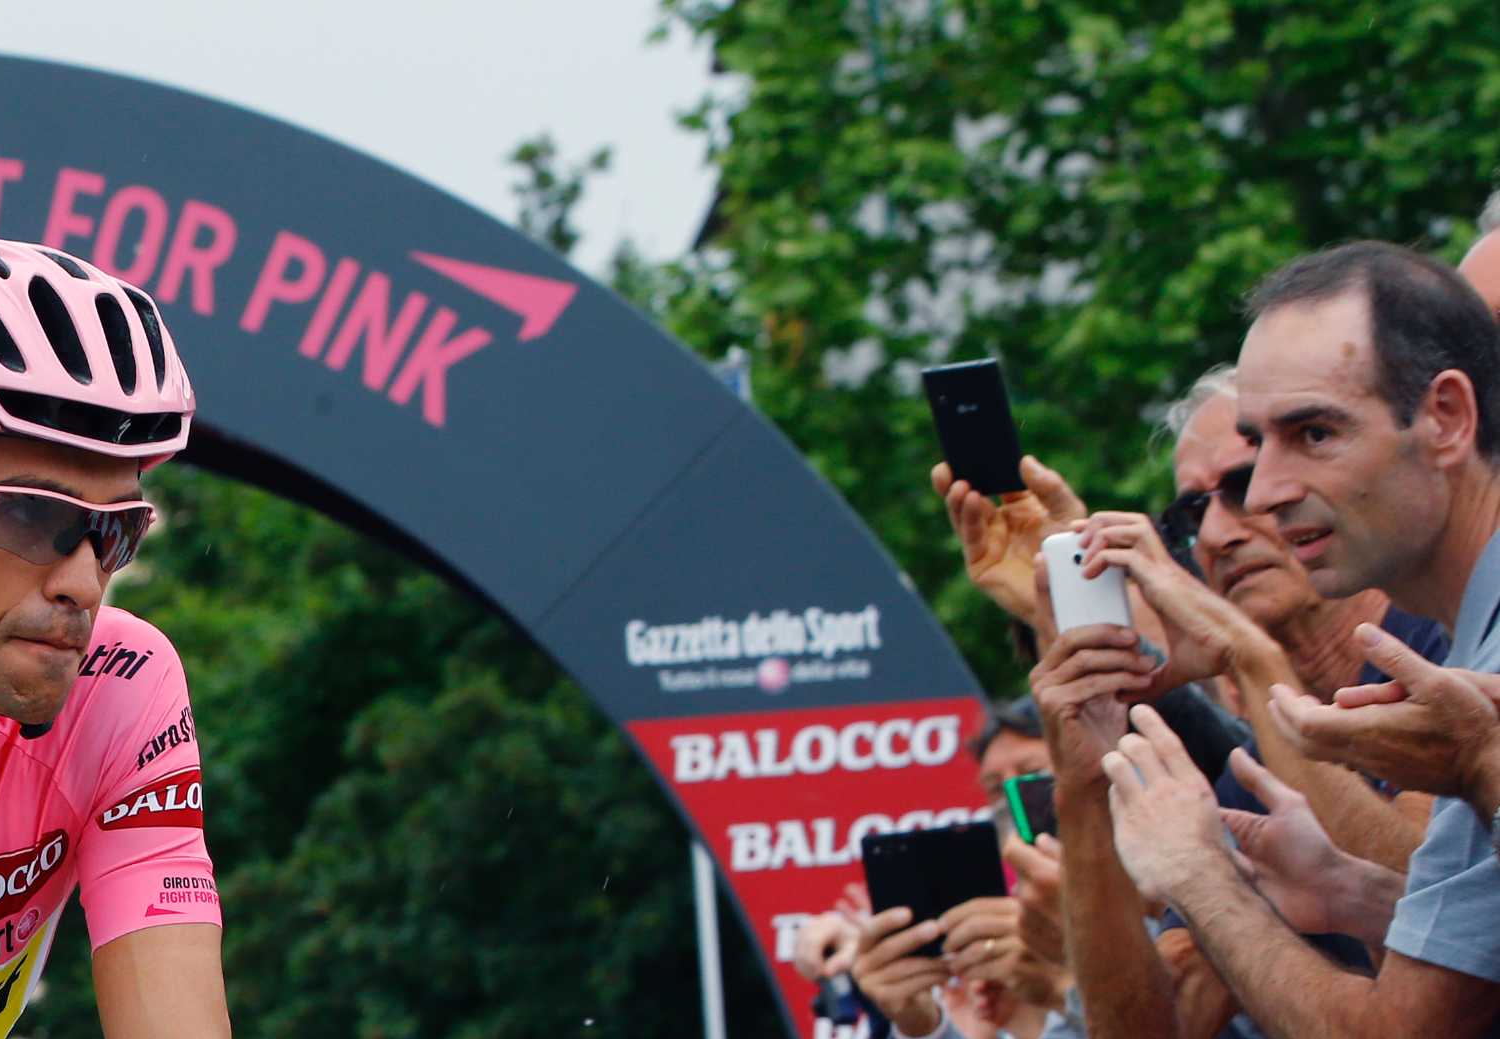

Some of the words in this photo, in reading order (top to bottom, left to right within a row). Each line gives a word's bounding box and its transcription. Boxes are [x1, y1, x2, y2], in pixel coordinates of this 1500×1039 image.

[42, 168, 237, 316] FOR
[241, 230, 493, 429] PINK
[625, 618, 741, 665] Gazzetta
[804, 604, 882, 659] Sport
[78, 641, 154, 681] tini
[670, 714, 960, 783] BALOCCO
[103, 781, 203, 824] BALO
[159, 891, 191, 904] FIGHT
[163, 876, 190, 889] GIRO
